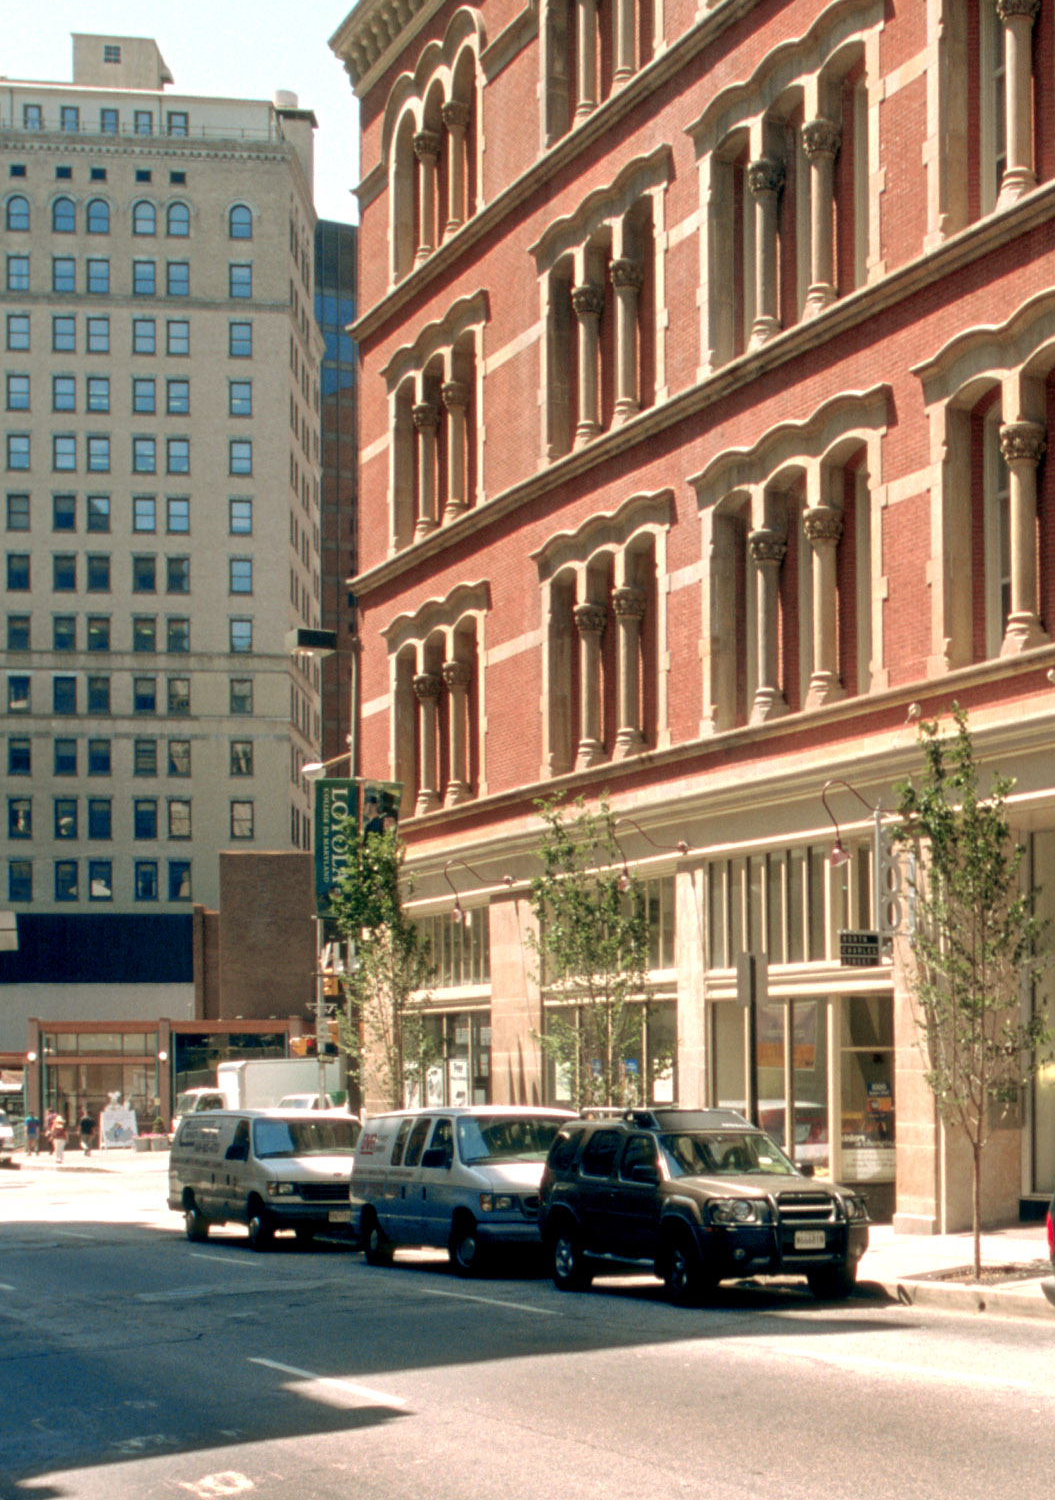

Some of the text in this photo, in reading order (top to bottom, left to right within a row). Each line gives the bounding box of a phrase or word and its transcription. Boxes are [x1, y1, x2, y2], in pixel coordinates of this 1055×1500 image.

[323, 826, 330, 836] IN
[331, 787, 349, 883] LOYOLA
[842, 946, 877, 955] CHARLES
